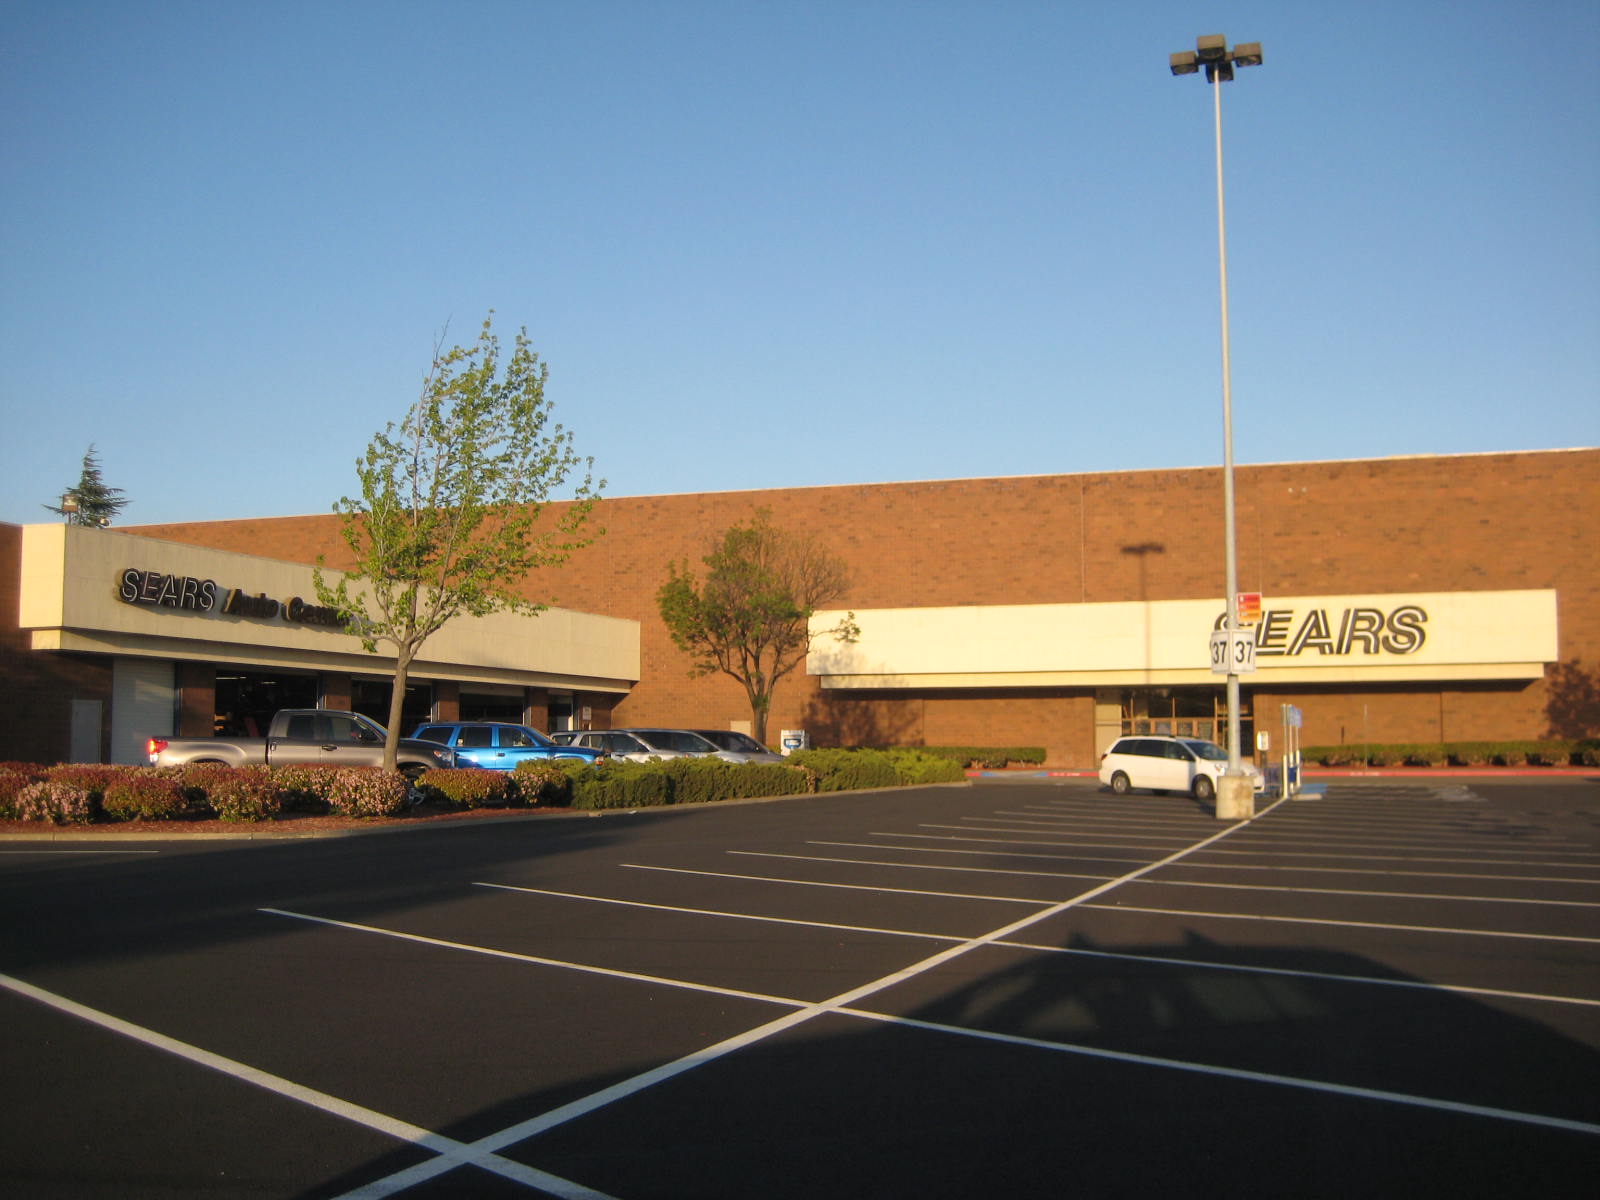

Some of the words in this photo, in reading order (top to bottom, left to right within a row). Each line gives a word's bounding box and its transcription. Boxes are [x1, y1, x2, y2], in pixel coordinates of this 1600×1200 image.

[119, 568, 217, 612] SEARS
[1212, 641, 1227, 664] 37
[1235, 640, 1253, 663] 37
